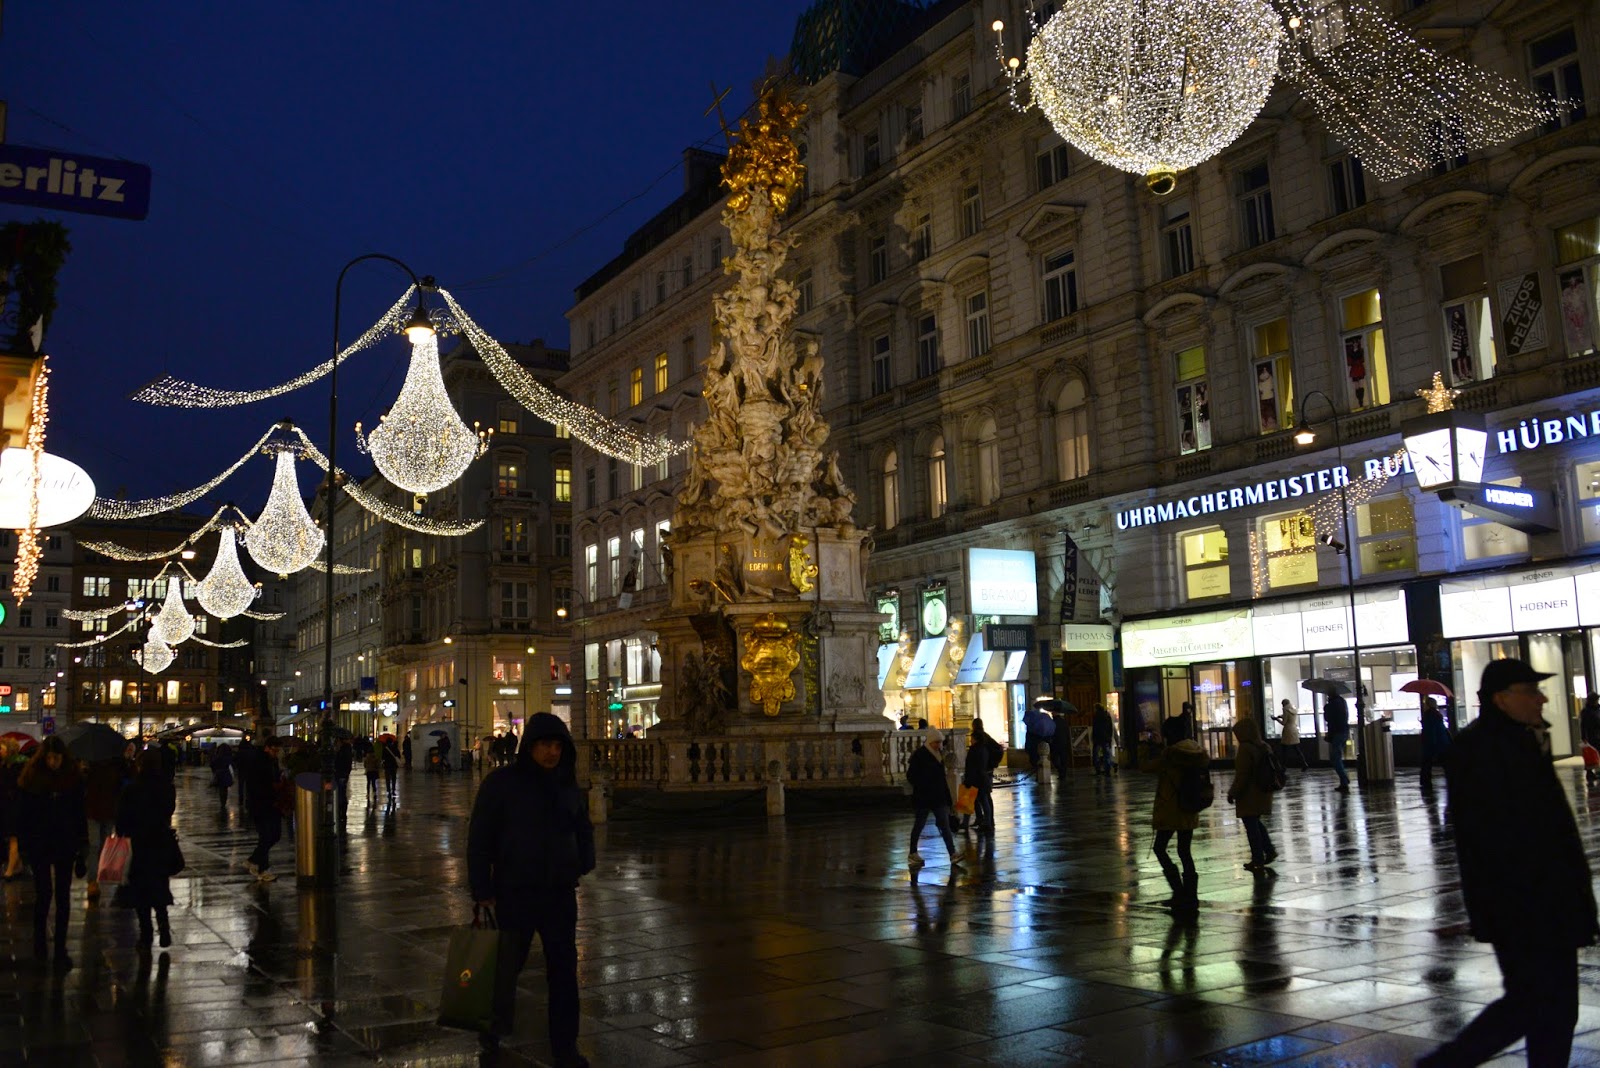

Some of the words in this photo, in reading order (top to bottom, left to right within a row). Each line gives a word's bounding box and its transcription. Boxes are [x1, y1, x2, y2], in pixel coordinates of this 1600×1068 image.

[0, 158, 126, 203] erlitz
[1507, 279, 1535, 326] ZIKOS
[1510, 301, 1541, 349] PELZE
[1116, 464, 1350, 530] UHRMACHERMEISTER
[1065, 547, 1076, 604] ZIKOS
[1078, 576, 1099, 586] PELZE
[1068, 632, 1113, 641] THOMAS
